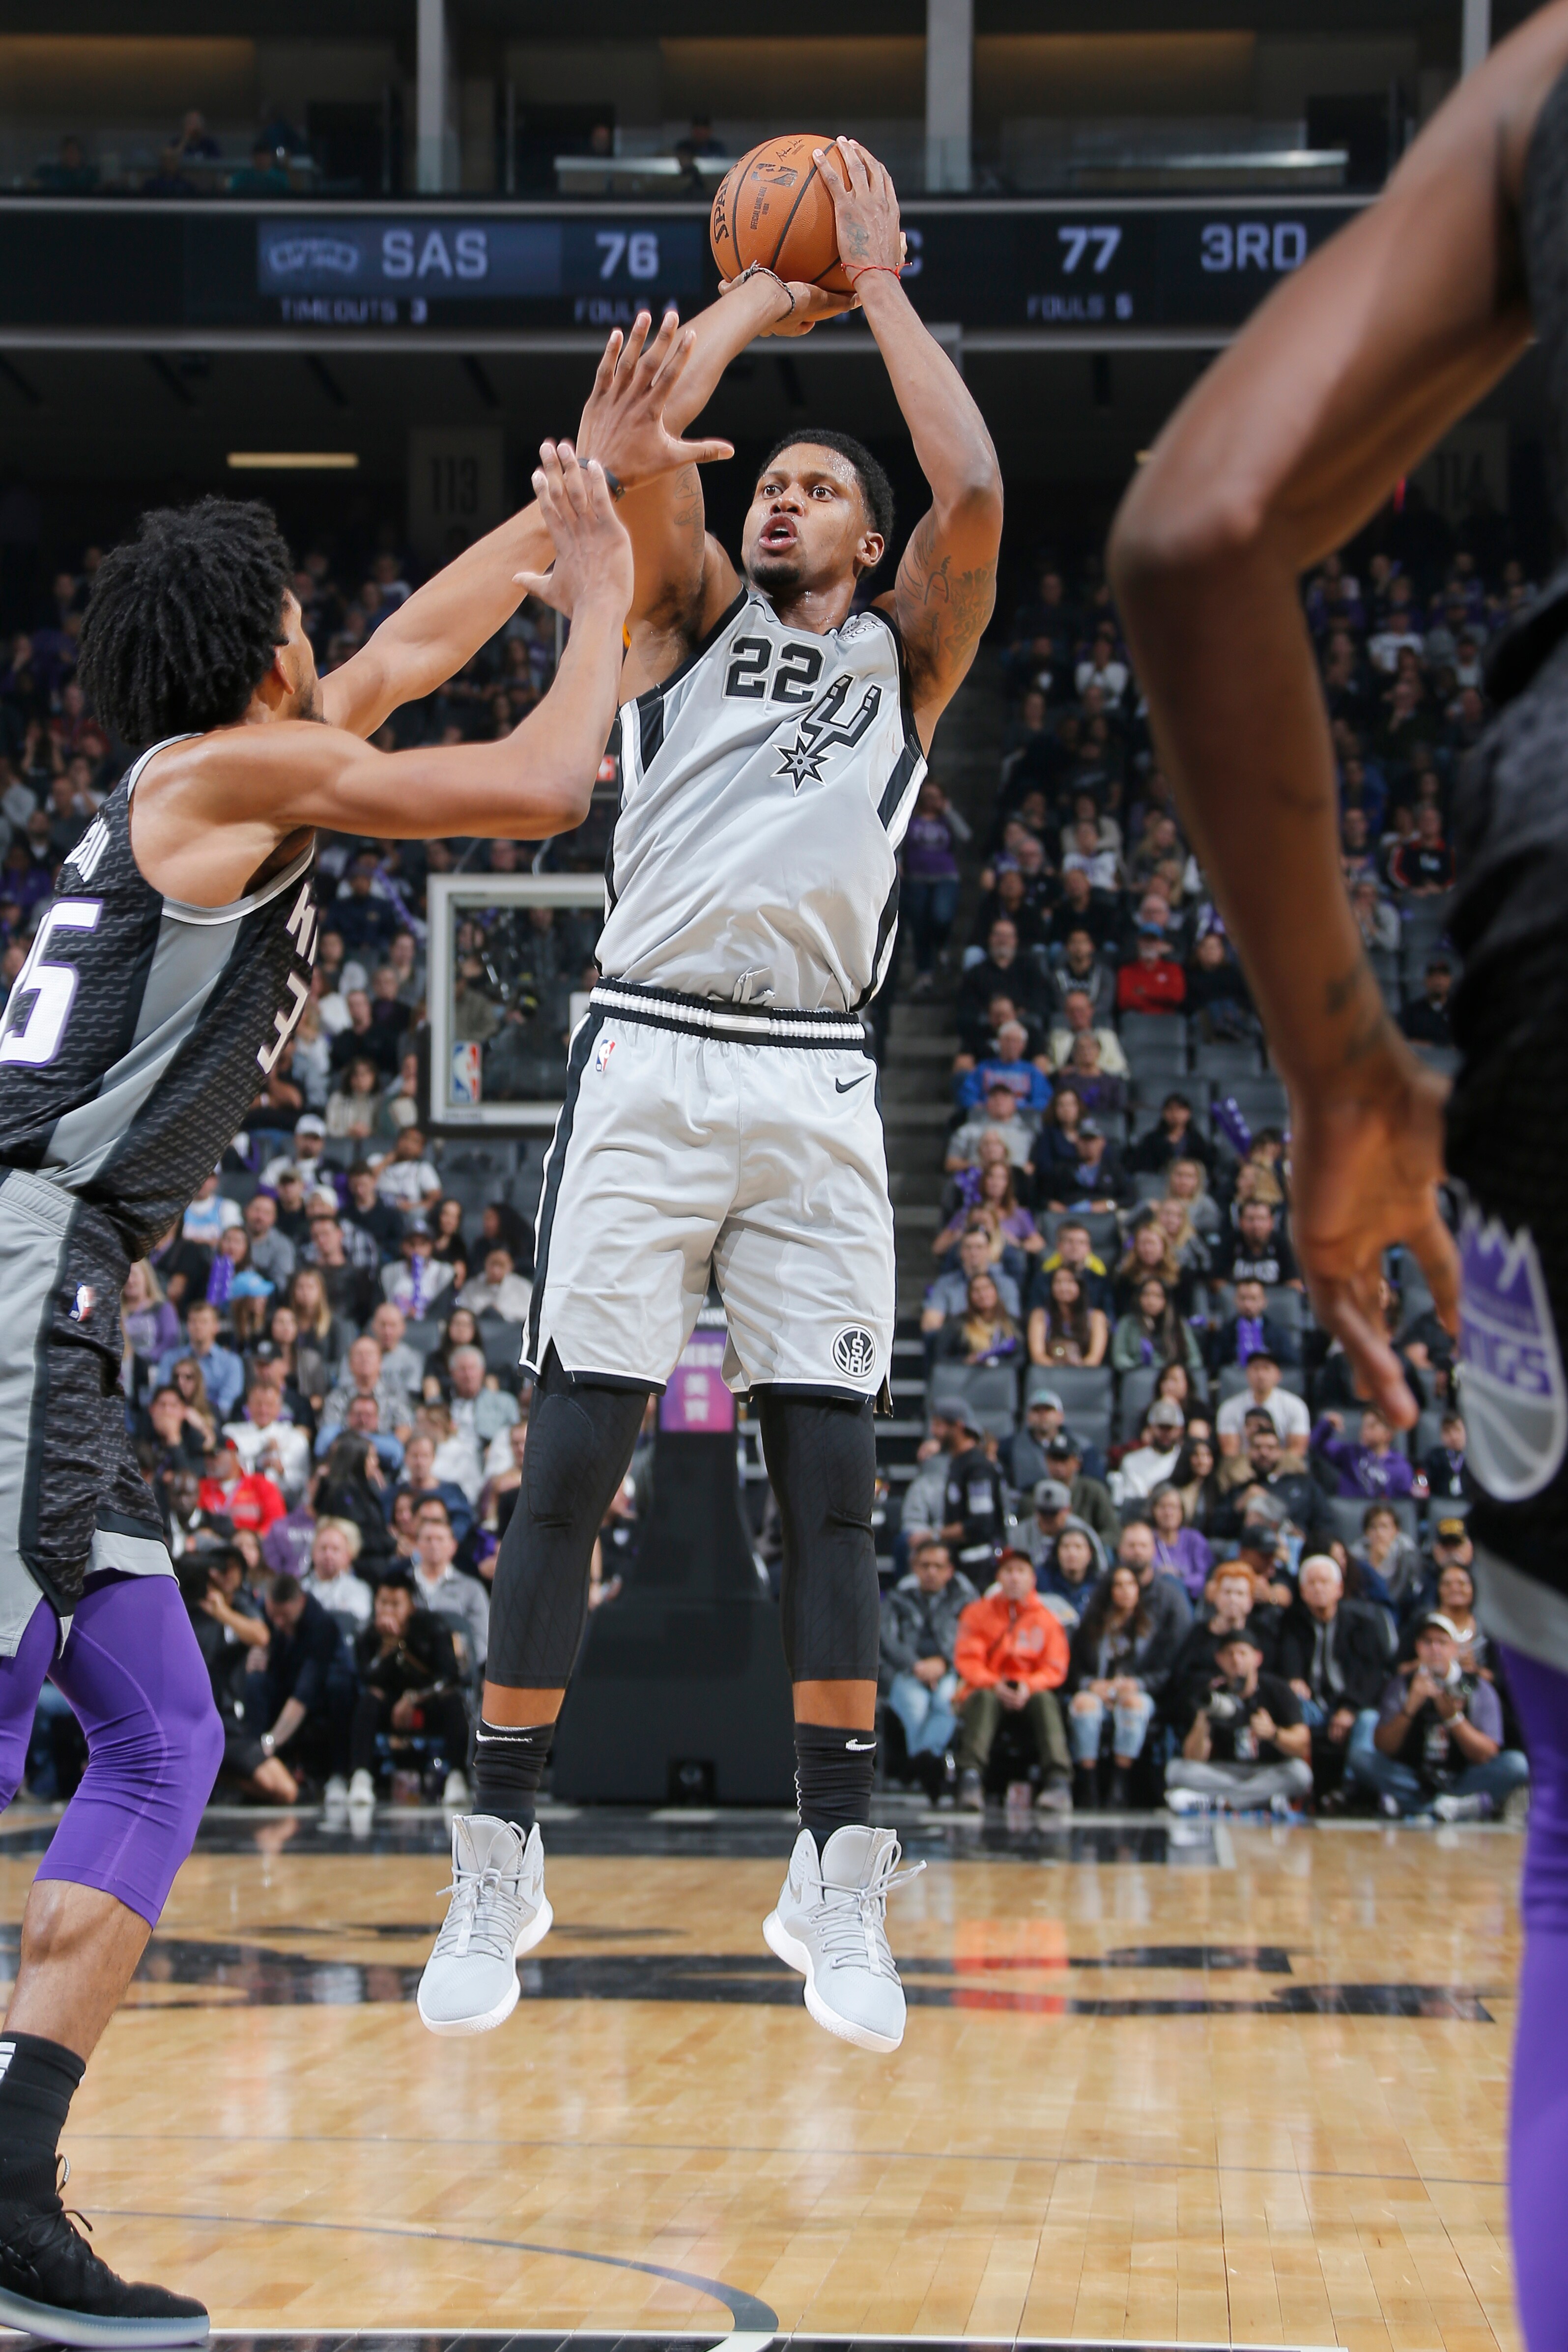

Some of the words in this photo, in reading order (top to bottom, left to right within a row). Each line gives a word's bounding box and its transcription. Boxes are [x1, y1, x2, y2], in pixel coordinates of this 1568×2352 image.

[381, 229, 488, 279] SAS
[595, 232, 659, 279] 76
[1057, 226, 1122, 275] 77
[1200, 222, 1308, 272] 3RD
[1026, 294, 1105, 320] FOULS
[722, 634, 826, 706] 22
